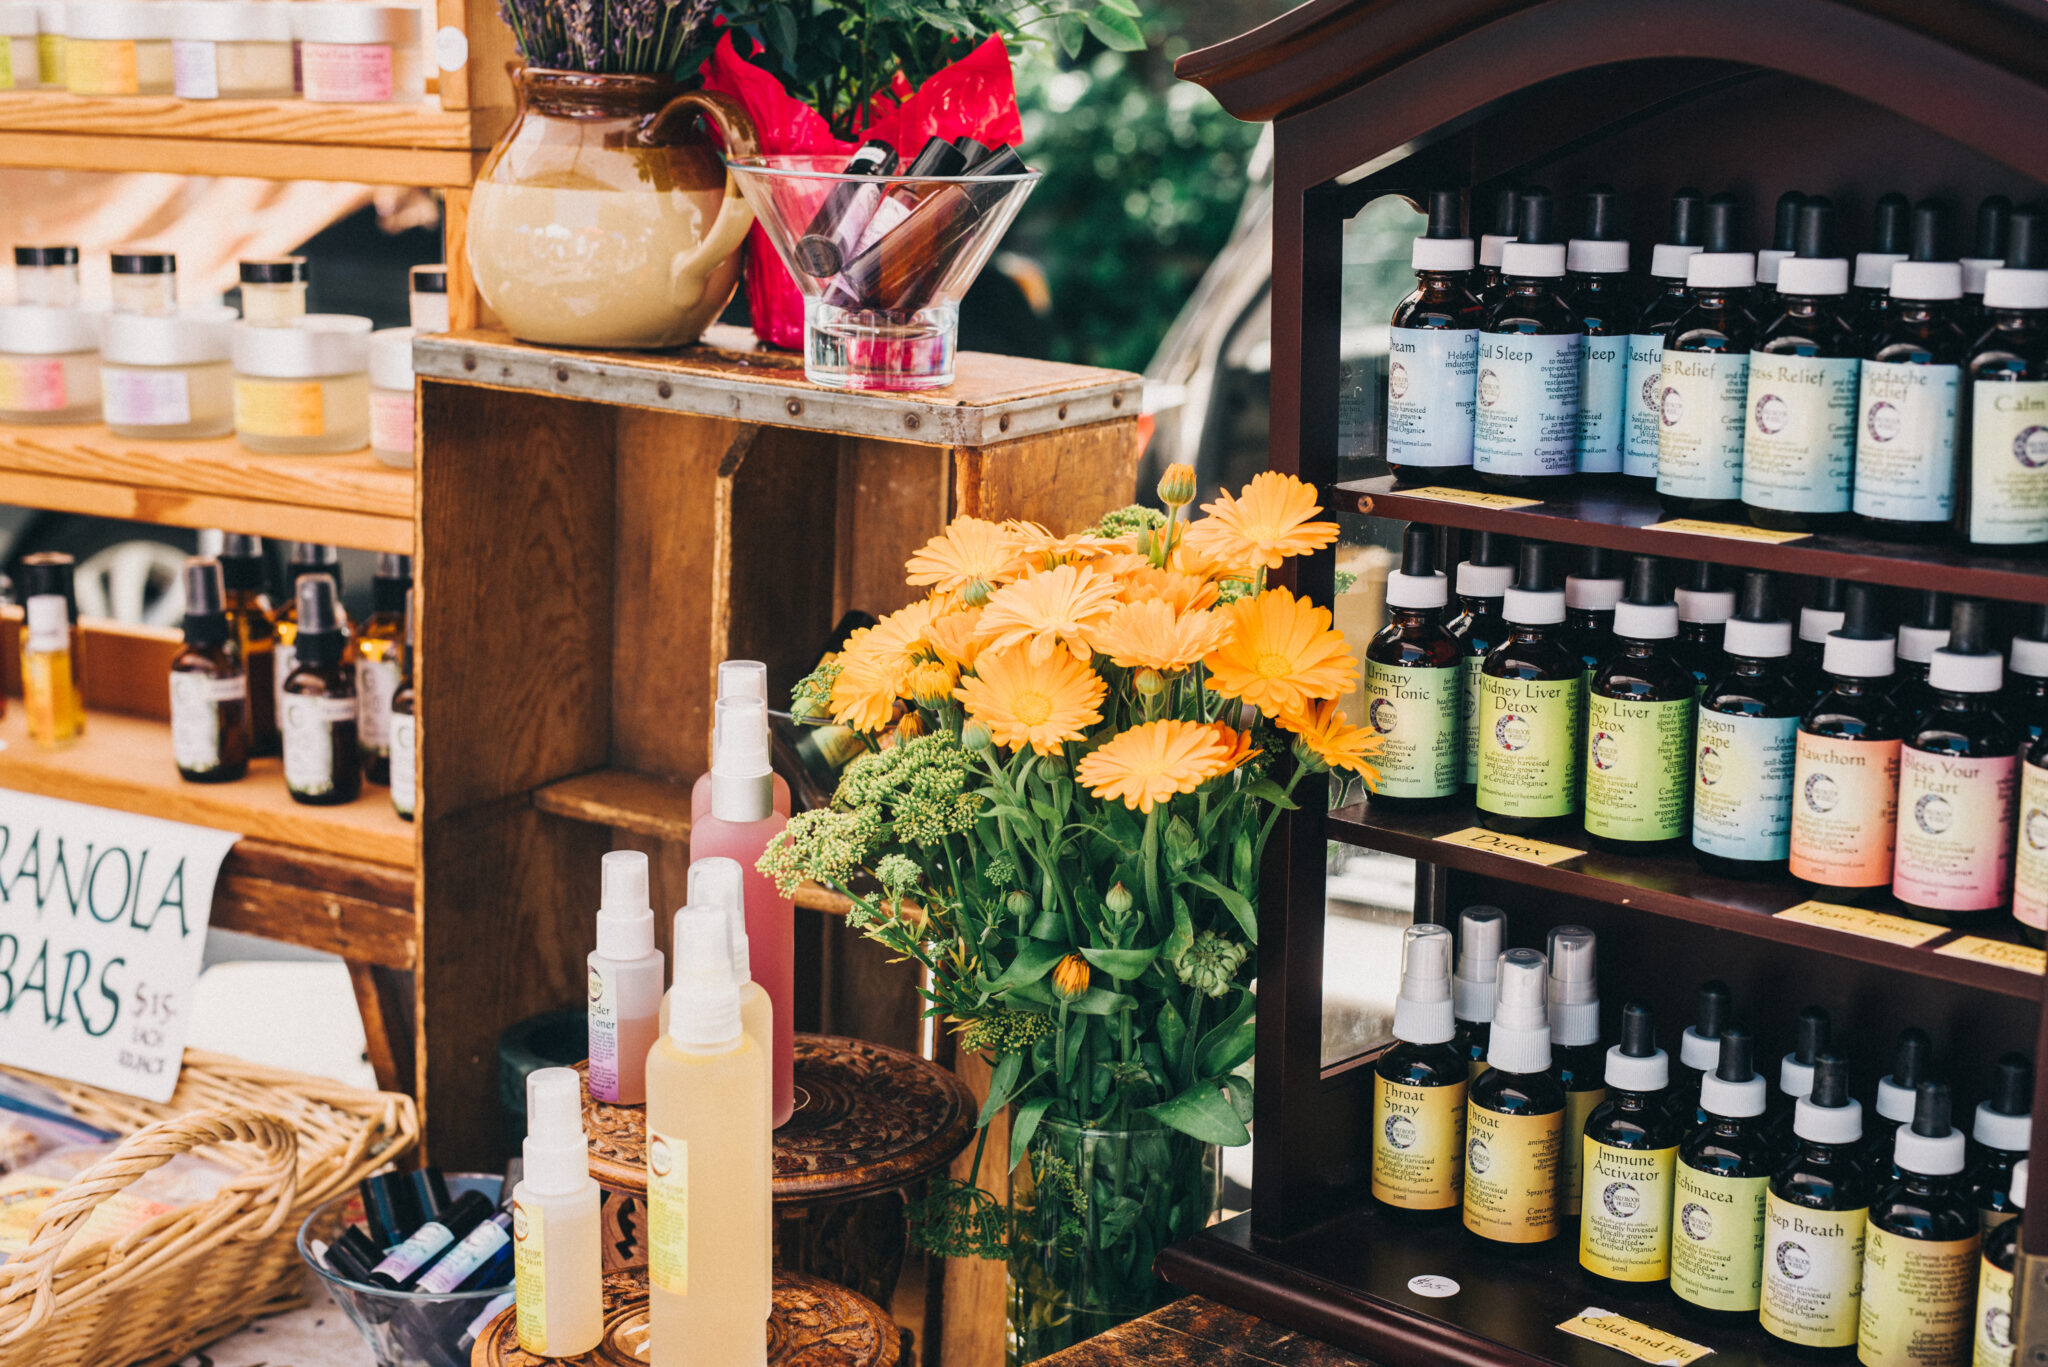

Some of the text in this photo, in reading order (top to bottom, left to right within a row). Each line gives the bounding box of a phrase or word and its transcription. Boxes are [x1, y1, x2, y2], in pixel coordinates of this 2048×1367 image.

[1496, 346, 1532, 363] Sleep
[1675, 361, 1716, 379] Relief
[1778, 367, 1825, 386] Relief
[1870, 384, 1907, 401] Relief
[1995, 395, 2046, 412] Calm
[1399, 425, 1422, 434] Organic
[1368, 664, 1411, 687] Urinary
[1392, 684, 1430, 699] Tonic
[1483, 677, 1561, 699] Kidney Liver
[1496, 697, 1538, 713] Detox
[1614, 702, 1650, 718] Liver
[1592, 713, 1625, 732] Detox
[1699, 710, 1735, 733] Oregon
[1386, 742, 1416, 751] harvested
[1699, 727, 1730, 749] Grape
[1799, 743, 1866, 766] Hawthorn
[1386, 762, 1411, 771] Organic
[1905, 753, 1980, 779] Bless Your
[1517, 780, 1544, 788] Organic
[1607, 780, 1638, 788] harvested
[1914, 774, 1958, 794] Heart
[1471, 835, 1547, 855] Detox
[0, 825, 190, 939] RANOLA
[1800, 905, 1851, 921] Heart
[0, 934, 125, 1036] BARS
[592, 1014, 615, 1029] Toner
[1384, 1081, 1424, 1101] Throat
[1384, 1097, 1419, 1116] Spray
[1469, 1103, 1499, 1128] Throat
[1469, 1121, 1494, 1142] Spray
[1599, 1146, 1655, 1166] Immune
[1404, 1175, 1429, 1183] Organic
[1593, 1161, 1659, 1180] Activator
[1678, 1171, 1733, 1203] Echinacea
[1479, 1201, 1502, 1212] Organic
[1591, 1216, 1658, 1233] Sustainably harvested
[1768, 1202, 1844, 1237] Deep Breath
[1593, 1225, 1602, 1234] and
[1604, 1228, 1624, 1239] locally
[1600, 1234, 1638, 1246] Wildcrafted
[1596, 1239, 1623, 1251] Certified
[1625, 1245, 1652, 1254] Organic
[1873, 1235, 1882, 1248] &
[1700, 1248, 1731, 1261] harvested
[1697, 1268, 1724, 1280] Organic
[1797, 1288, 1831, 1299] harvested
[1582, 1316, 1693, 1360] Colds and Flu
